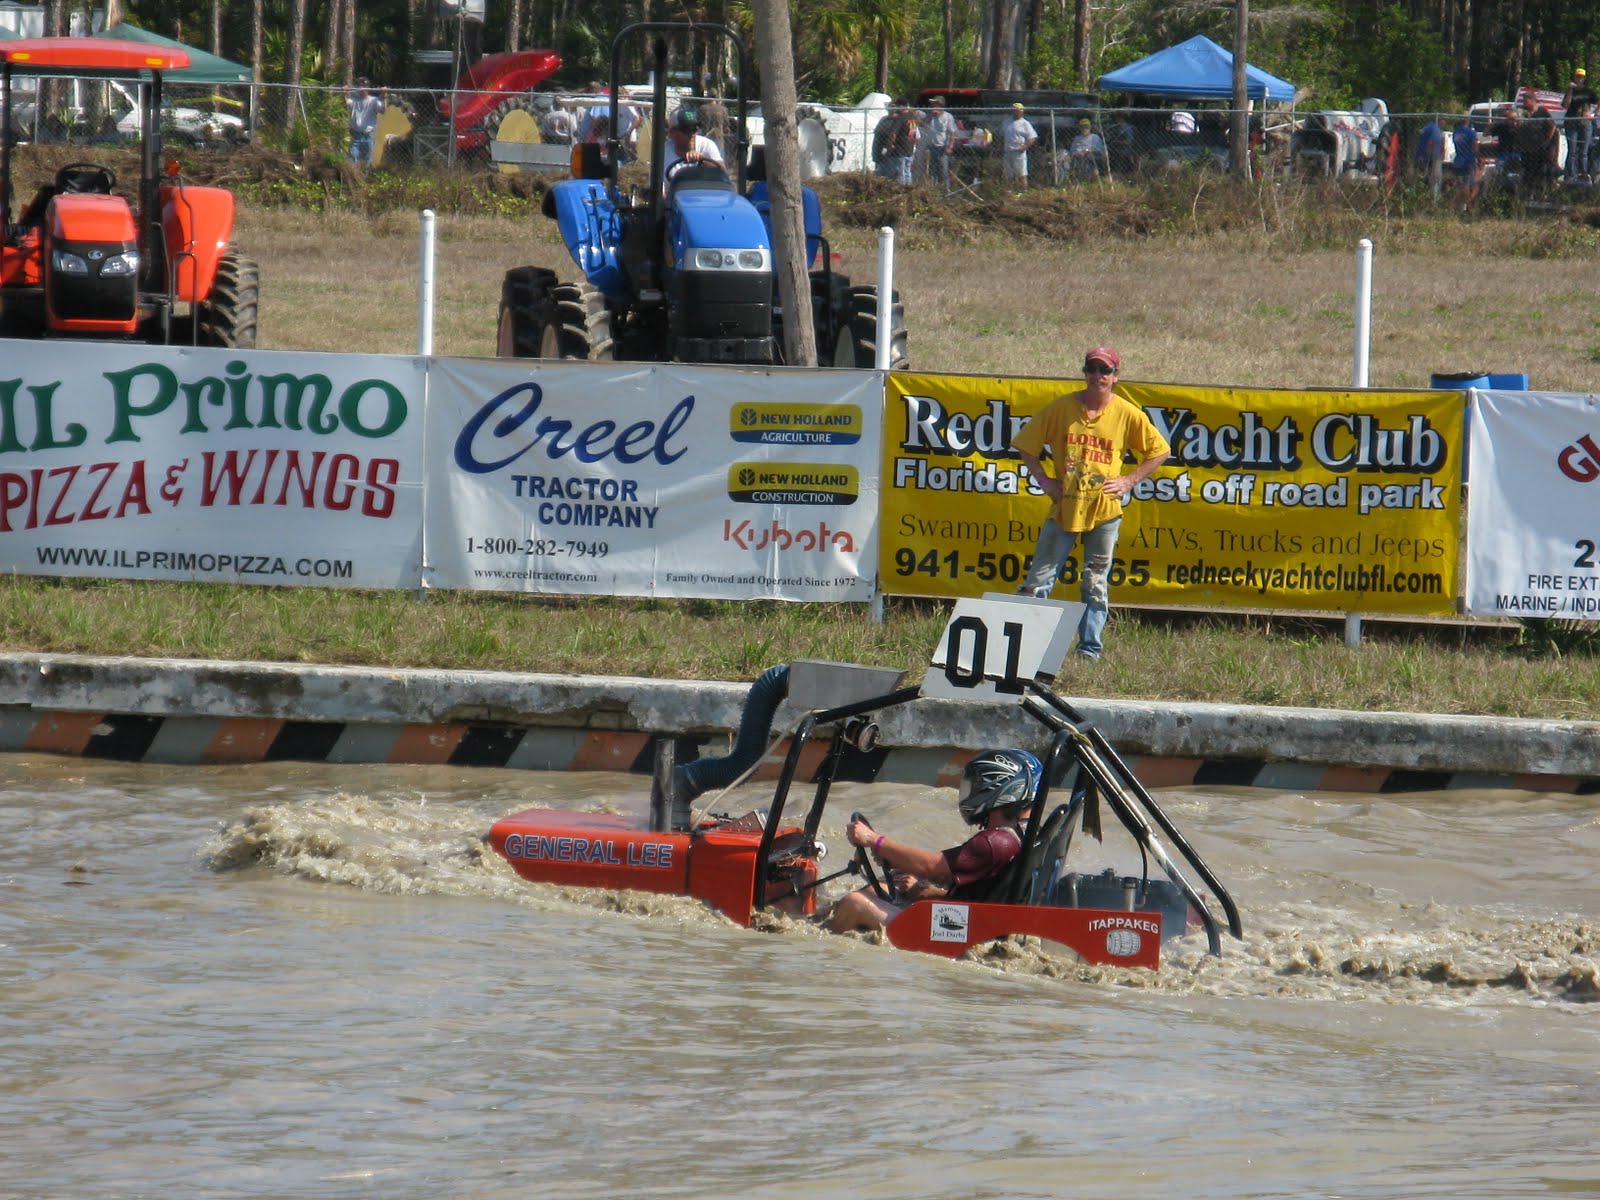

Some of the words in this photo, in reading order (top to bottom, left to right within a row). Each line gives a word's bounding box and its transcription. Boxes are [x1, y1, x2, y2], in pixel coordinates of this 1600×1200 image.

[454, 382, 695, 474] Creel
[760, 413, 791, 425] NEW
[793, 414, 852, 426] HOLLAND
[760, 431, 832, 443] AGRICULTURE
[1144, 406, 1296, 464] Yacht
[1311, 412, 1441, 468] Club
[0, 459, 152, 532] PIZZA
[159, 457, 189, 507] &
[199, 448, 400, 519] WINGS
[511, 474, 638, 502] TRACTOR
[759, 473, 789, 485] NEW
[791, 474, 849, 486] HOLLAND
[894, 457, 1047, 497] Florida's
[1202, 473, 1256, 505] off
[1262, 476, 1348, 507] road
[1358, 477, 1446, 515] park
[751, 491, 834, 503] CONSTRUCTION
[538, 501, 659, 529] COMPANY
[465, 536, 609, 559] 1-800-282-7949
[723, 518, 854, 553] Kubota
[898, 513, 998, 546] Swamp
[1130, 526, 1203, 552] ATVs,
[1214, 529, 1302, 554] Trucks
[1311, 531, 1362, 557] and
[1369, 533, 1446, 563] Jeeps
[36, 546, 353, 579] WWW.ILPRIMOPIZZA.COM
[474, 568, 597, 583] www.creeltractor.com
[1166, 557, 1443, 595] redneckyachtclubfl.com
[666, 572, 699, 585] Family
[701, 574, 734, 585] Owned
[736, 574, 755, 585] and
[757, 575, 802, 588] Operated
[805, 576, 831, 587] Since
[833, 577, 856, 587] 1972
[1528, 573, 1563, 591] FIRE
[1568, 575, 1600, 592] EXT
[1496, 594, 1558, 612] MARINE
[944, 615, 1025, 696] 01
[505, 833, 621, 865] GENERAL
[626, 842, 674, 868] LEE
[932, 930, 945, 938] Joel
